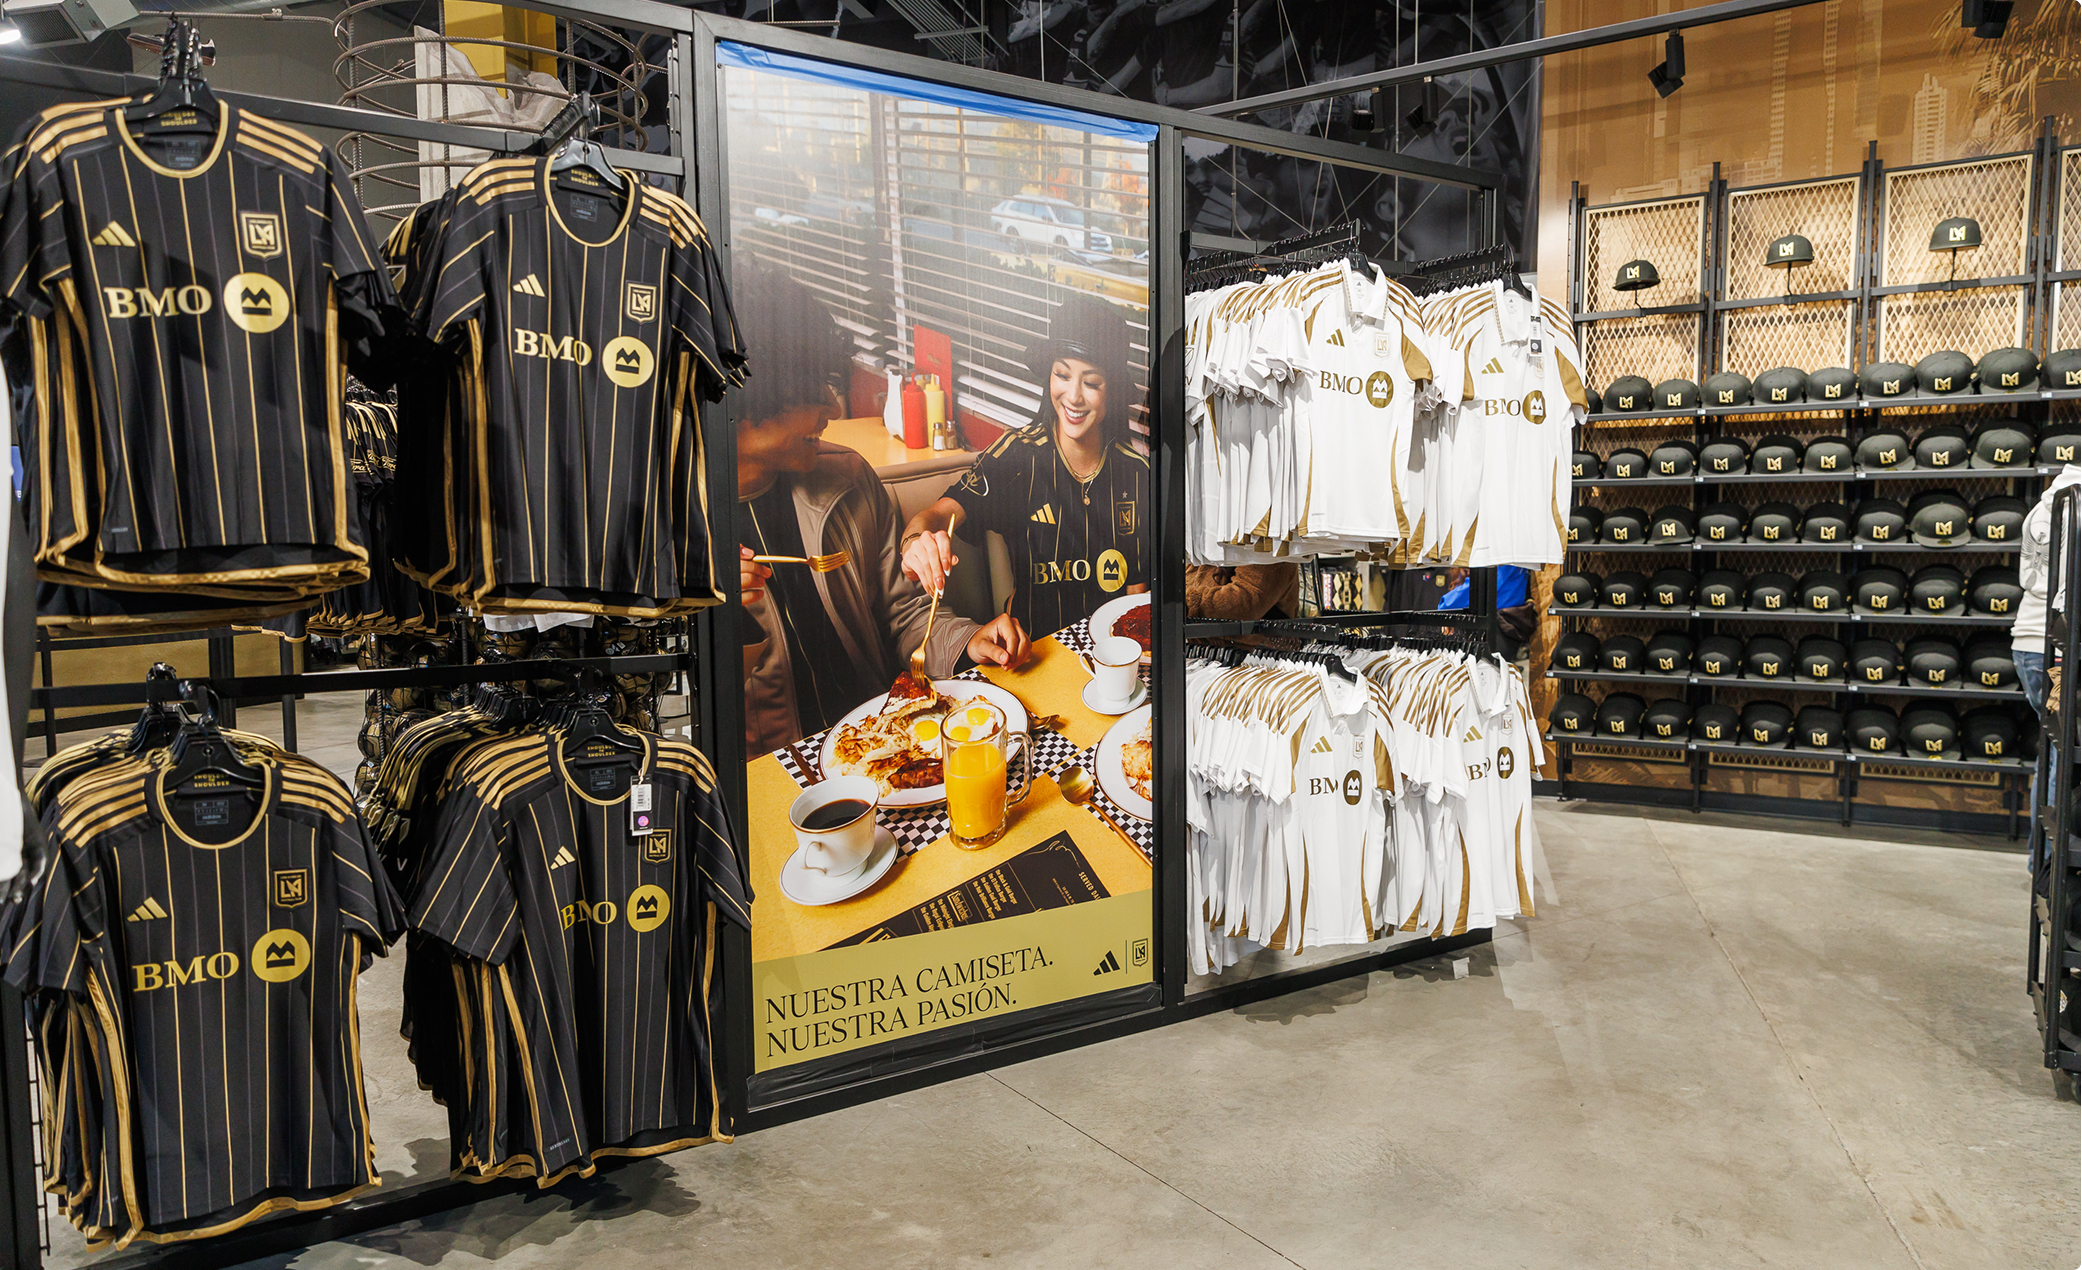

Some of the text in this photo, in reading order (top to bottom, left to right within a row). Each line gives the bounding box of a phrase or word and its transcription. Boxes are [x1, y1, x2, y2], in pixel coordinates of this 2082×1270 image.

[103, 284, 213, 319] BMO
[514, 327, 592, 367] BMO
[1319, 370, 1363, 395] BMO
[1033, 559, 1091, 585] BMO
[1078, 871, 1094, 891] SERVED
[132, 951, 240, 992] BMO
[765, 946, 1054, 1025] NUESTRA CAMISETA.
[766, 982, 1018, 1058] NUESTRA PASIÓN.
